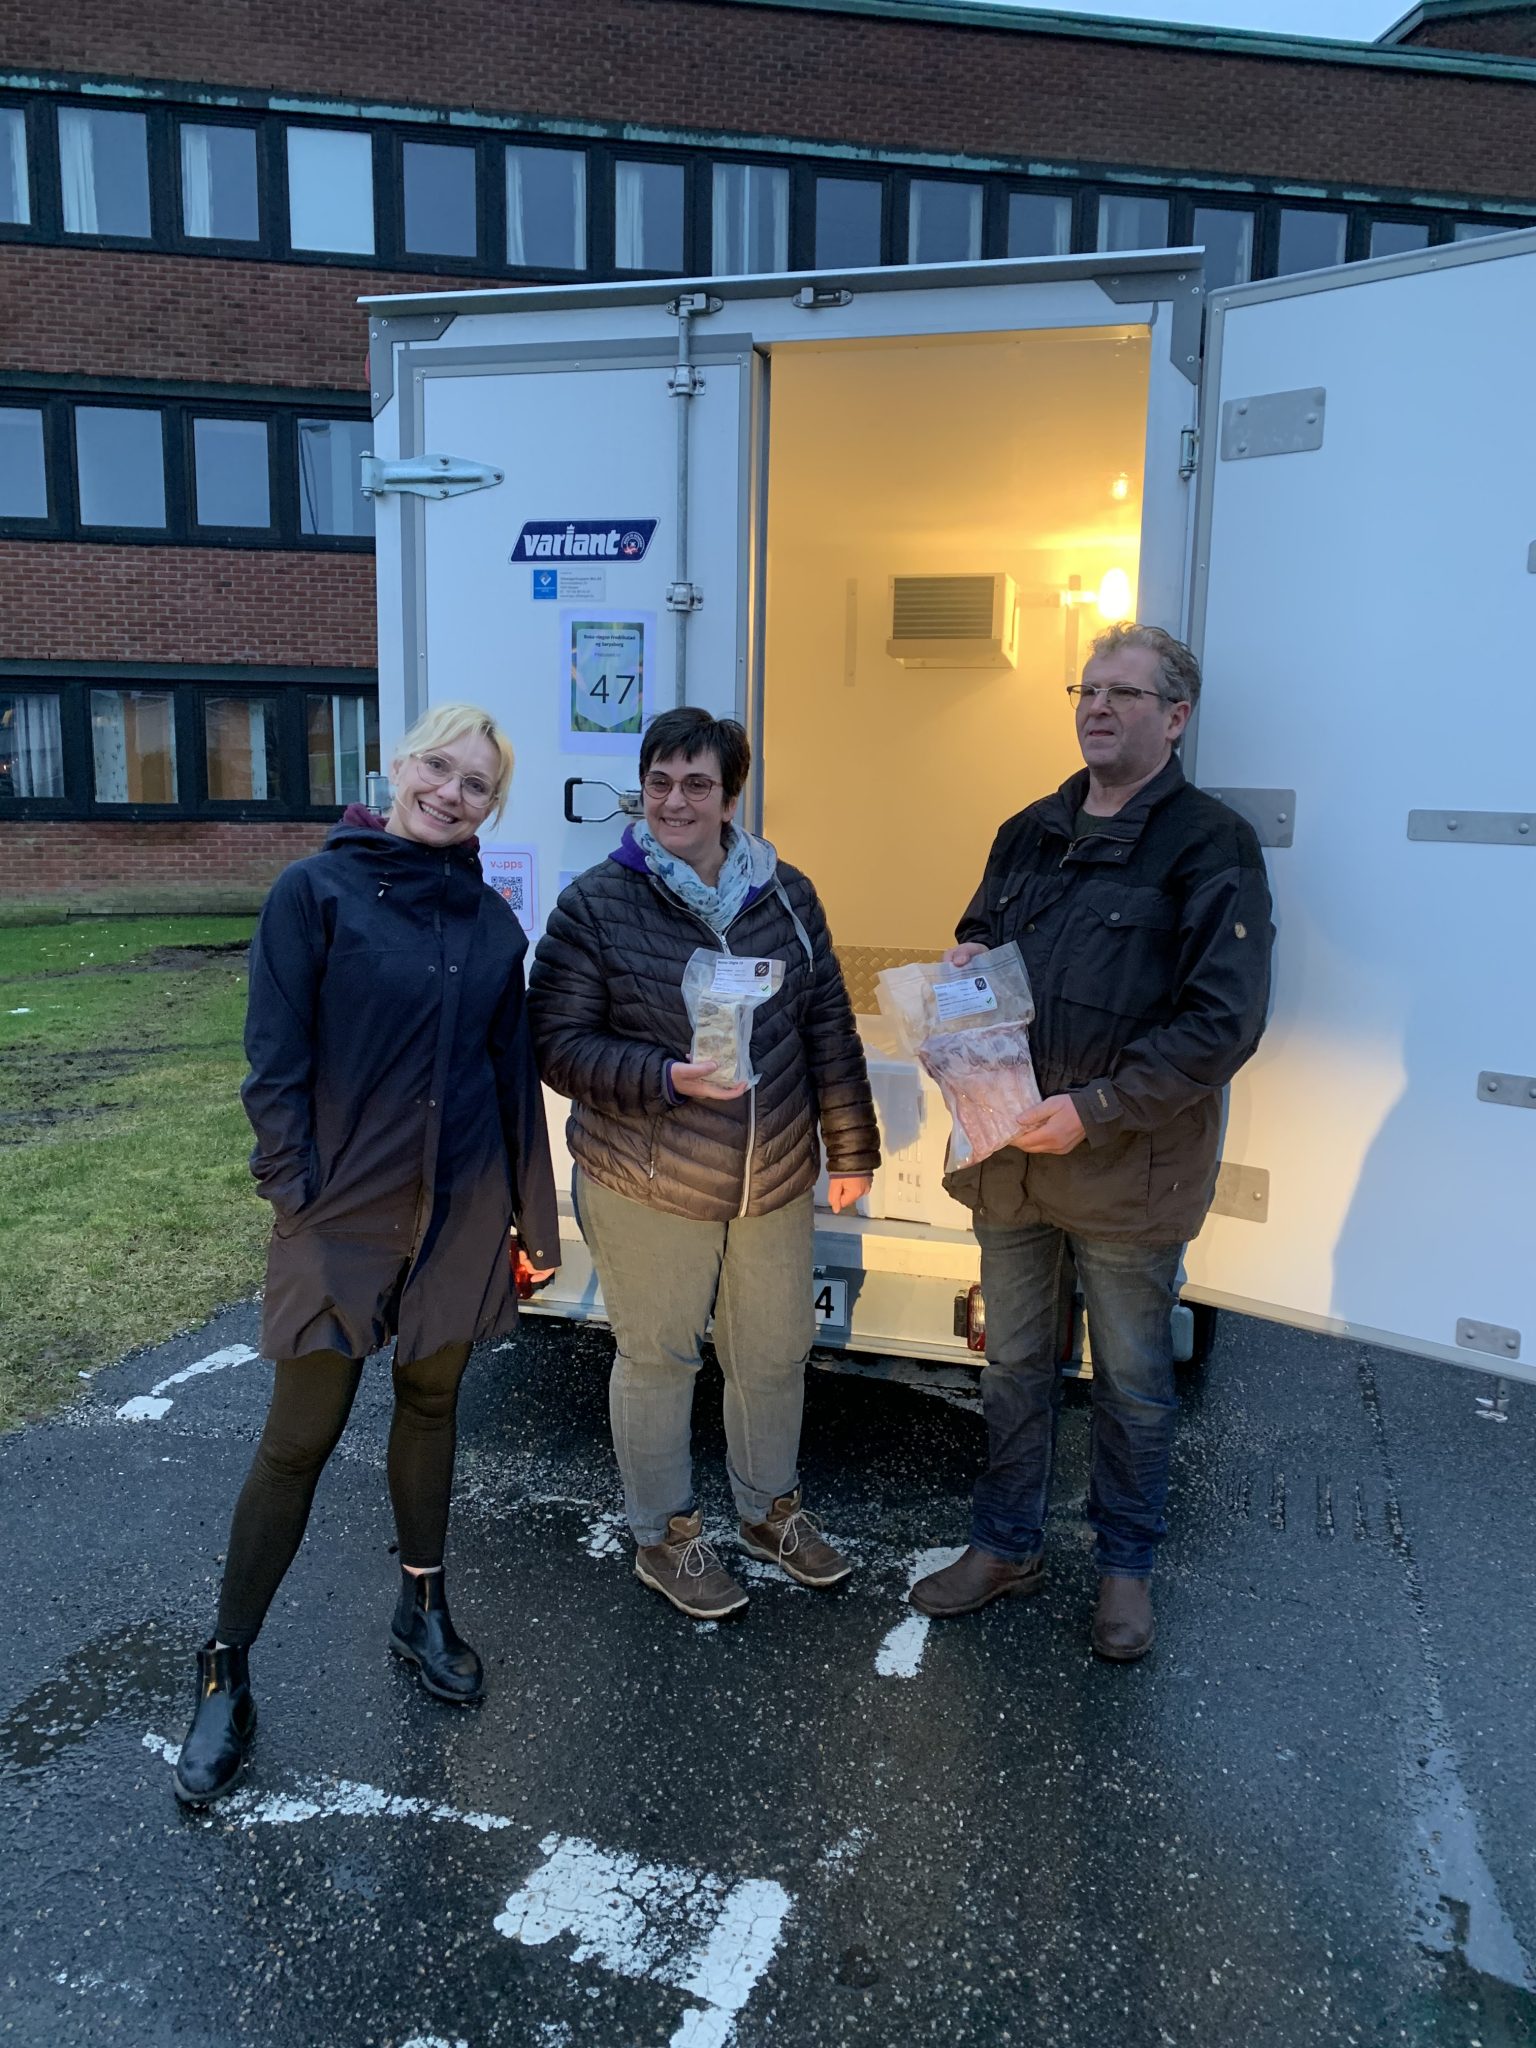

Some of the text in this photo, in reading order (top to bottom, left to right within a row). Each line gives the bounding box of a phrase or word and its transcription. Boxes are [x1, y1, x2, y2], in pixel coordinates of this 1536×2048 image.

[523, 524, 620, 557] variant
[589, 674, 636, 704] 47
[814, 1285, 834, 1319] 4
